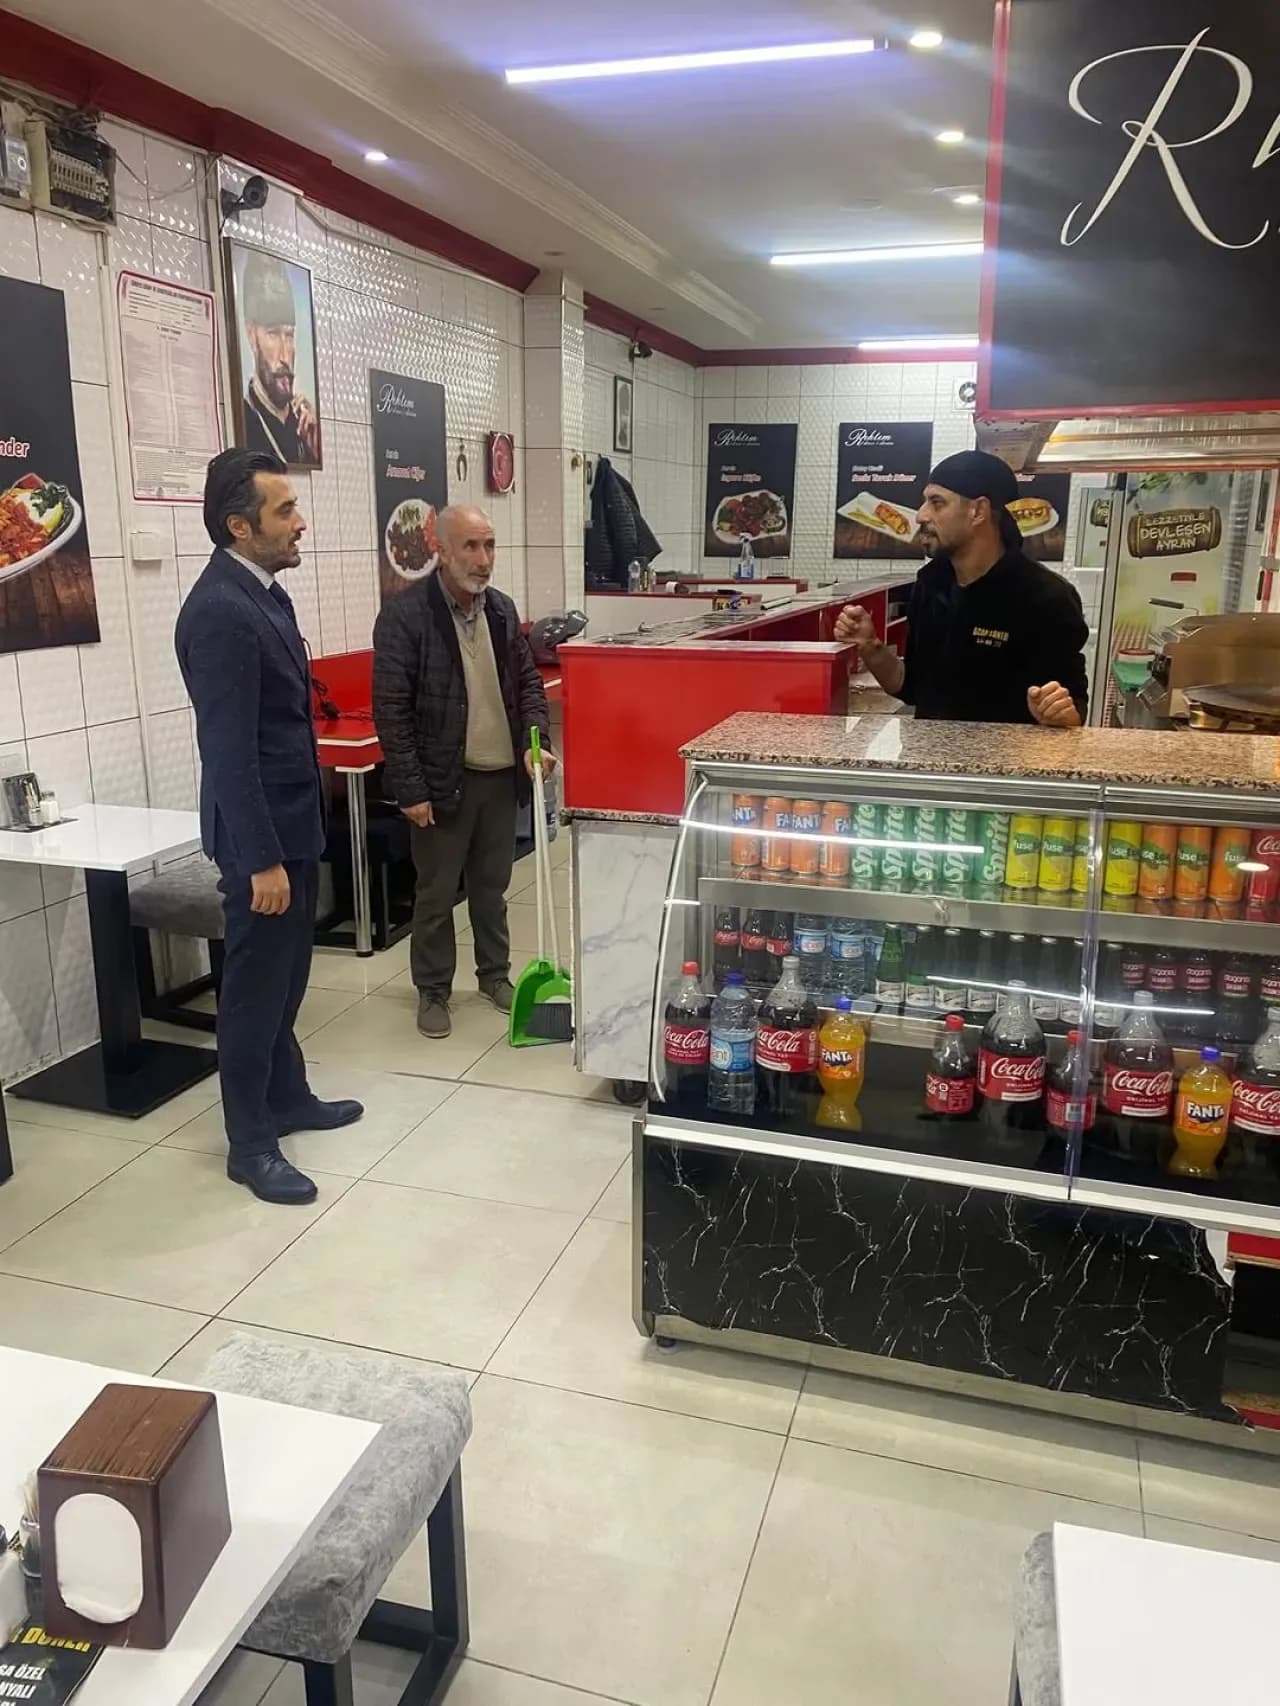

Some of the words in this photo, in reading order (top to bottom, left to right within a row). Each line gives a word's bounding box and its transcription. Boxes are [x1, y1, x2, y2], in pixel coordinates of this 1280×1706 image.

[1140, 520, 1212, 540] DEVLESEN
[1155, 536, 1197, 551] AYRAN
[13, 1663, 46, 1681] ÖZEL
